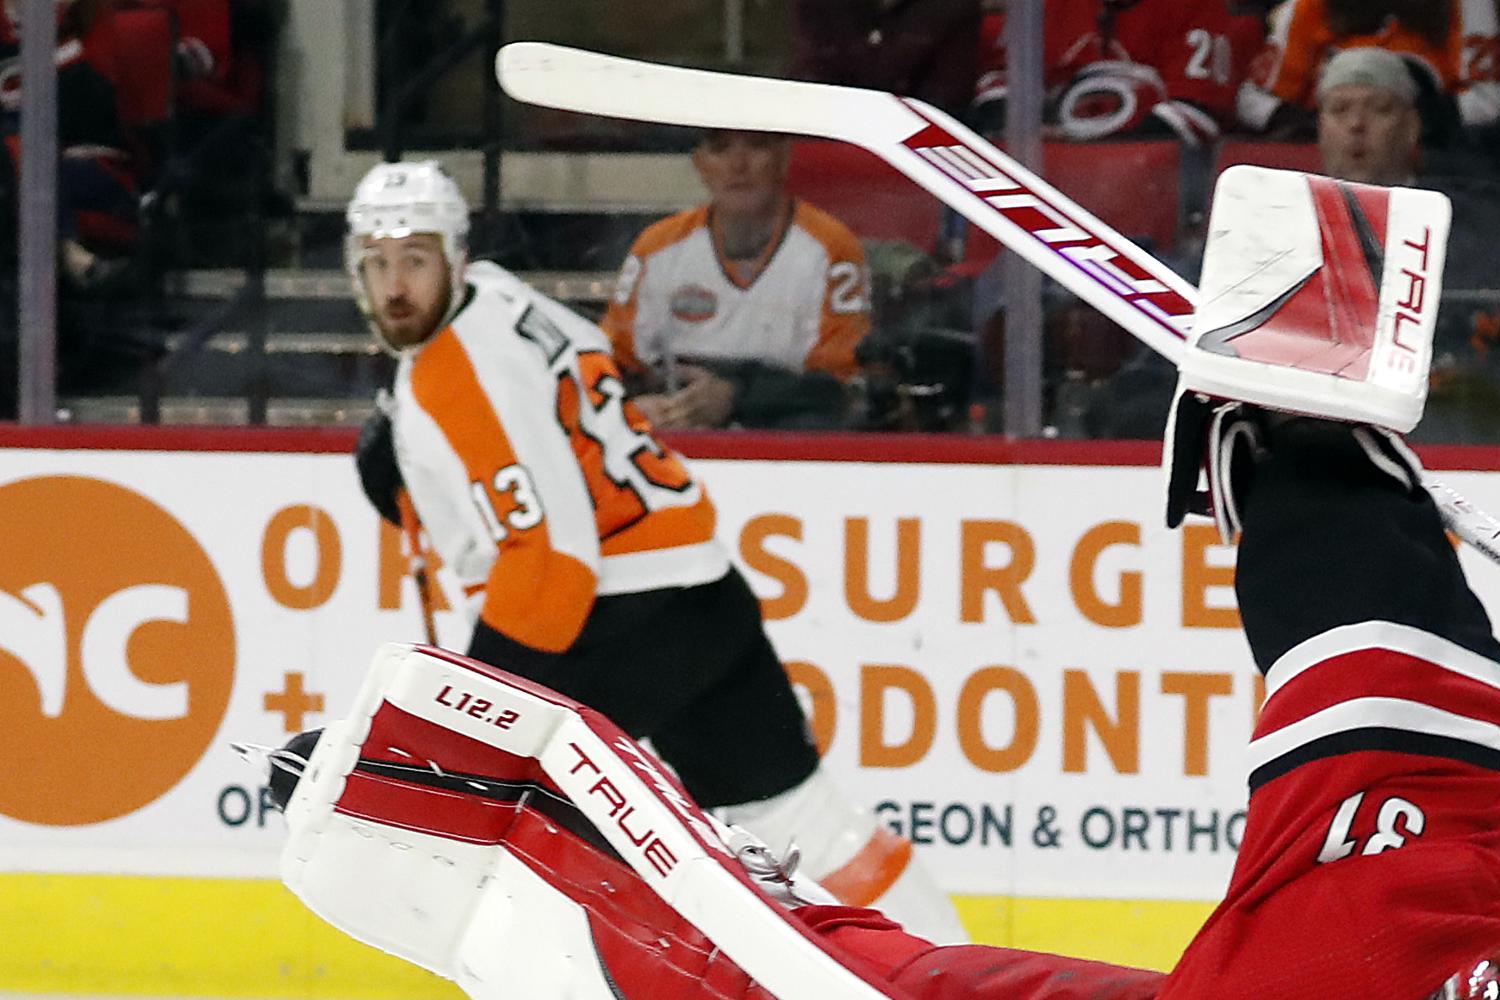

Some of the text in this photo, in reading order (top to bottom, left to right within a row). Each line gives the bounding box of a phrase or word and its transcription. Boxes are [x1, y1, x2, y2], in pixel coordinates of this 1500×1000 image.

[1387, 225, 1431, 375] TRUE
[471, 462, 545, 542] 13
[434, 684, 521, 731] L12.2
[587, 741, 679, 878] TRUE
[1315, 789, 1427, 865] 31
